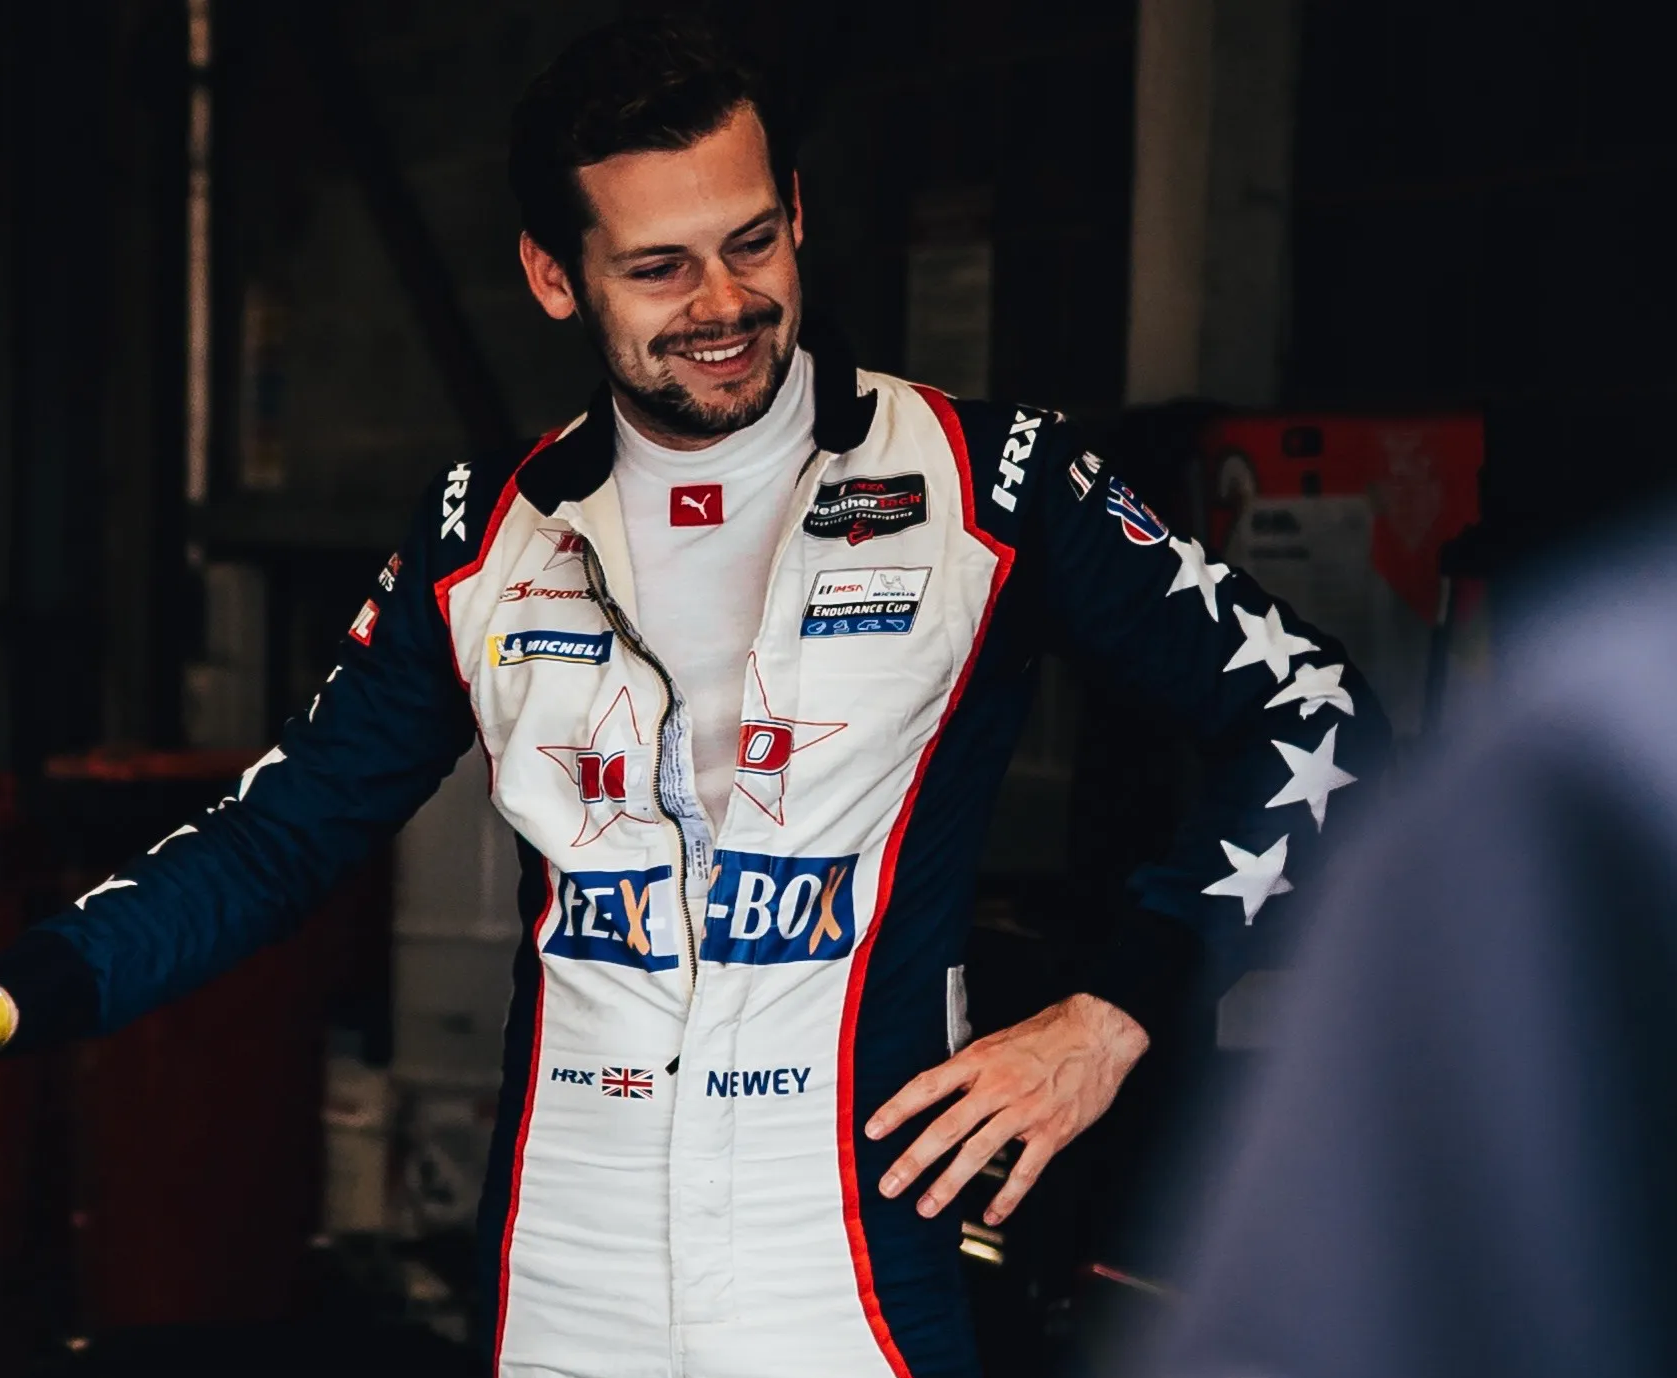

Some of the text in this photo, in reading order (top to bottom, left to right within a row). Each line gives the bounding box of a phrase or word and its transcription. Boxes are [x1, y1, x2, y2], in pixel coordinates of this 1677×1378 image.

[991, 410, 1043, 513] HRX
[440, 461, 470, 542] HRX
[813, 602, 911, 617] ENDURANCE CUP
[551, 1067, 596, 1086] HRX
[706, 1066, 812, 1098] NEWEY
